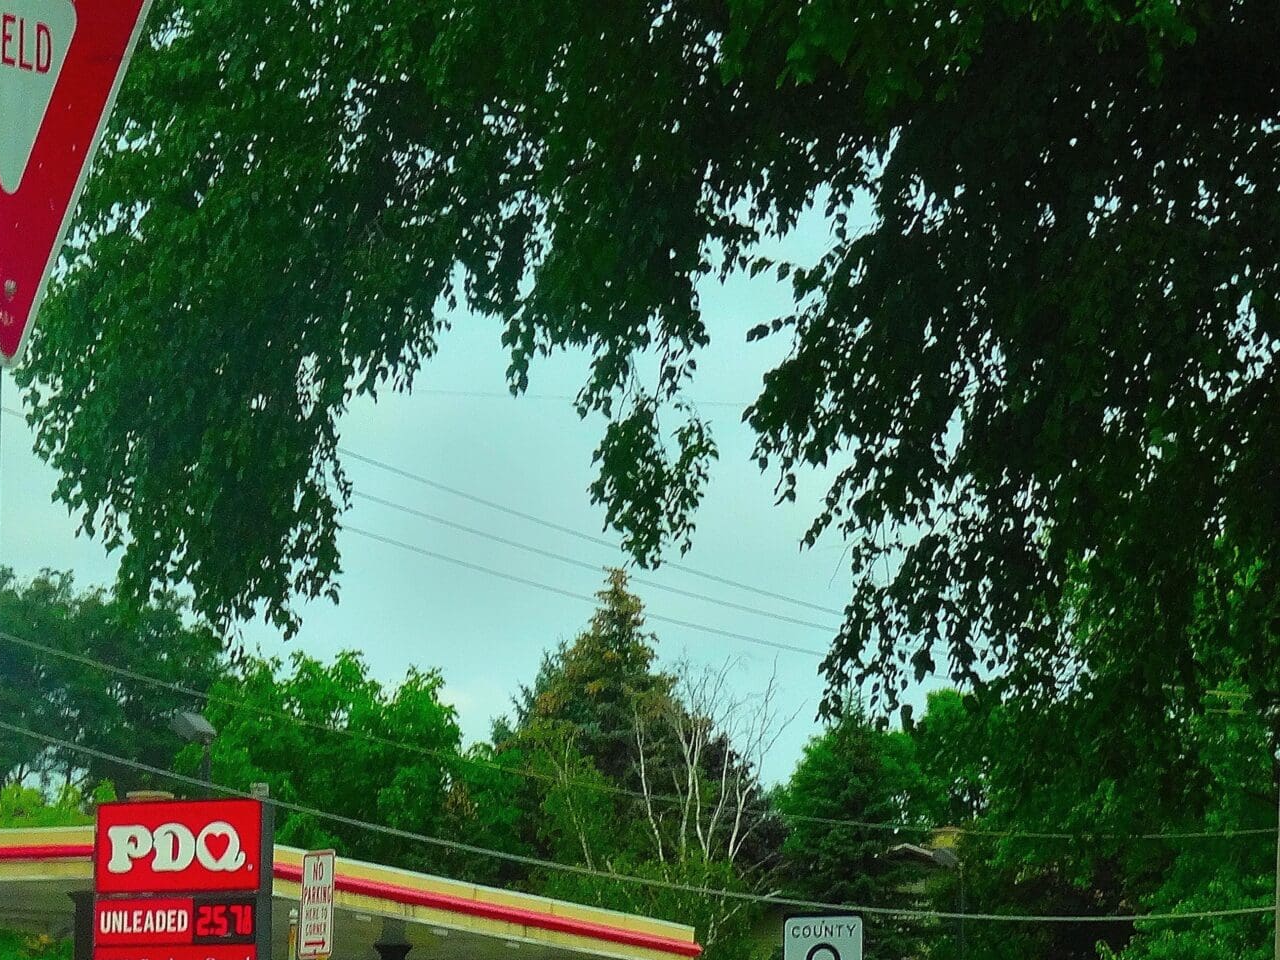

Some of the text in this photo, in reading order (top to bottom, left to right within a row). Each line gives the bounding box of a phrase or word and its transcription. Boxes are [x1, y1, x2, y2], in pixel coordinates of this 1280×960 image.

[107, 821, 246, 874] PDQ
[312, 861, 324, 881] NO
[303, 886, 332, 904] PARKING
[100, 910, 189, 934] UNLEADED
[305, 907, 320, 920] HERE
[305, 923, 326, 936] CORNER
[791, 924, 857, 939] COUNTY
